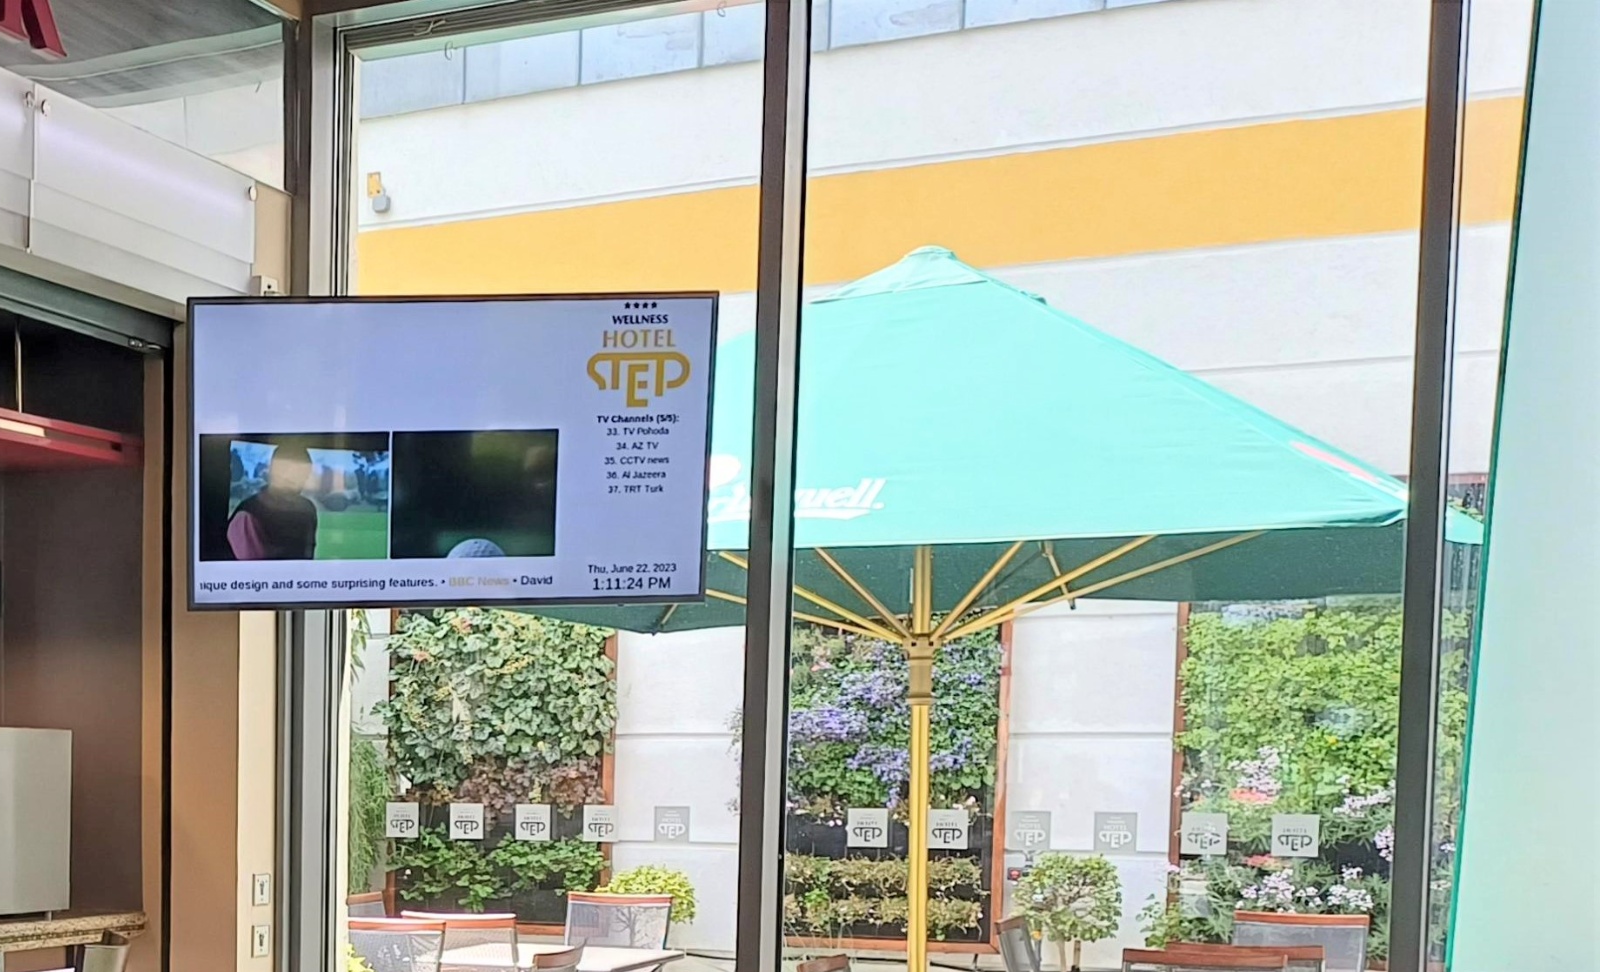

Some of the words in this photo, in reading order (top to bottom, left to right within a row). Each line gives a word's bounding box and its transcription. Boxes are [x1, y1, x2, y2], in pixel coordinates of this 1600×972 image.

[612, 314, 669, 325] WELLNESS
[602, 328, 677, 349] HOTEL
[586, 351, 691, 408] STEP
[597, 415, 609, 423] TV
[611, 414, 654, 423] Channels
[623, 427, 636, 436] TV
[637, 426, 670, 435] Pohoda
[646, 441, 659, 450] TV
[619, 456, 646, 465] CCTV
[624, 485, 642, 494] TRT
[588, 564, 609, 574] Thu,
[611, 564, 634, 573] June
[653, 563, 677, 573] 2023
[230, 580, 269, 593] design
[271, 580, 294, 590] and
[296, 580, 328, 590] some
[331, 578, 386, 591] surprising
[389, 577, 438, 589] features.
[520, 575, 553, 586] David
[593, 577, 644, 591] 1:11:24
[648, 576, 672, 590] PM
